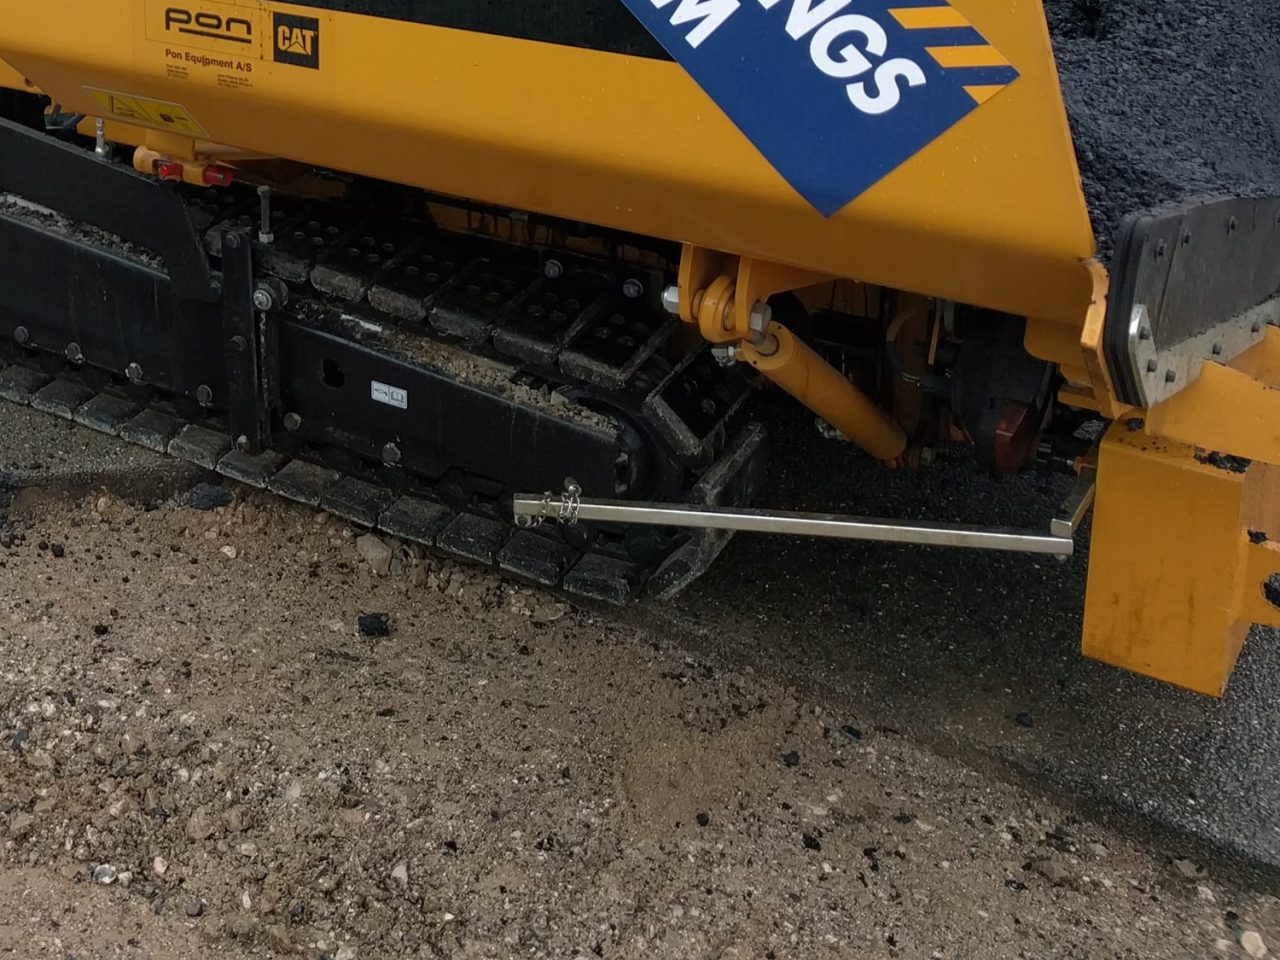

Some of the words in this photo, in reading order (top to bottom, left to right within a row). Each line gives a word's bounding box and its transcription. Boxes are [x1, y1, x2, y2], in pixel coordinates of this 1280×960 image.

[277, 24, 316, 55] CAT
[165, 48, 183, 60] Pon
[185, 52, 234, 69] Equipment
[236, 61, 253, 72] A/S
